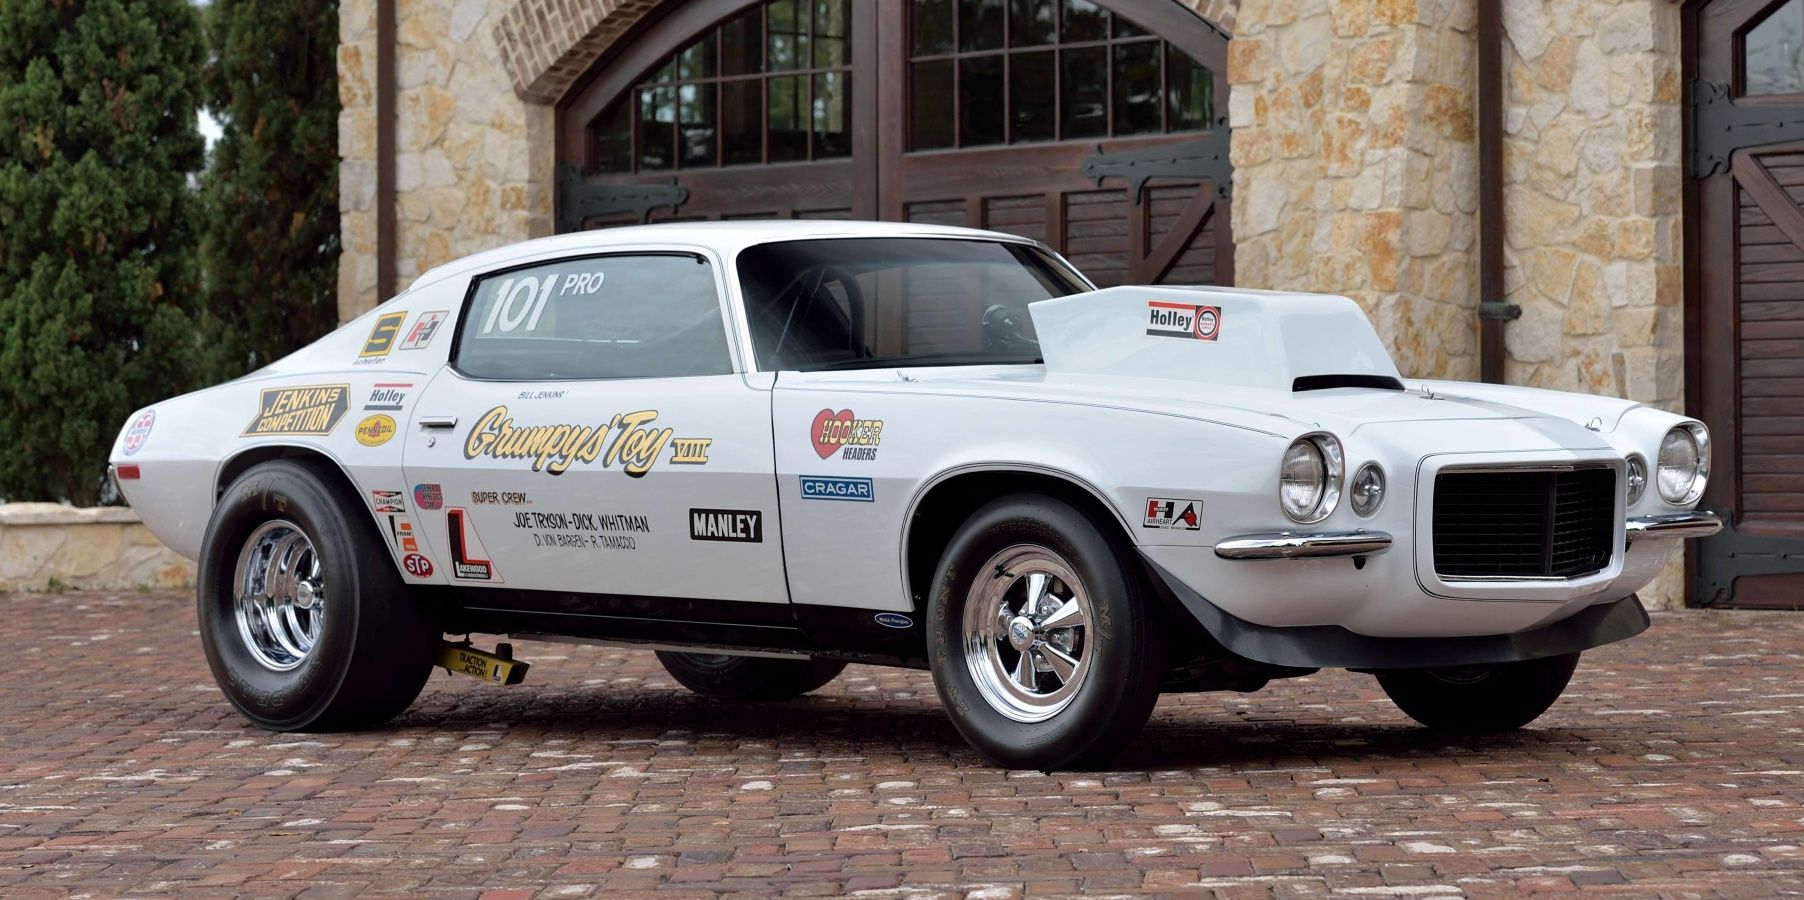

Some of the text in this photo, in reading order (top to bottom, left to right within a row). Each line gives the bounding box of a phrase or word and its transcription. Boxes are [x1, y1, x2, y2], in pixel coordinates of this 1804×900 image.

[483, 272, 605, 334] 101 PRO
[1150, 309, 1192, 331] Holley
[263, 388, 341, 417] JENKINS
[369, 389, 406, 405] Holley
[517, 391, 534, 399] BILL
[256, 402, 336, 432] COMPETITION
[357, 424, 393, 437] PENNZOIL
[819, 419, 884, 446] HOOKER
[602, 410, 673, 478] Toy
[669, 438, 712, 465] VIII
[843, 447, 878, 461] HEADERS
[804, 482, 869, 496] CRAGAR
[375, 497, 402, 506] CHAMPION
[472, 491, 499, 504] SUPER
[513, 512, 533, 529] JOE
[598, 514, 650, 533] WHITMAN
[693, 512, 757, 539] MANLEY
[1147, 518, 1173, 526] AIRHEART
[543, 533, 557, 547] VON
[406, 555, 430, 574] STP
[455, 561, 488, 577] LAKEWOOD
[460, 652, 487, 669] TRACTION
